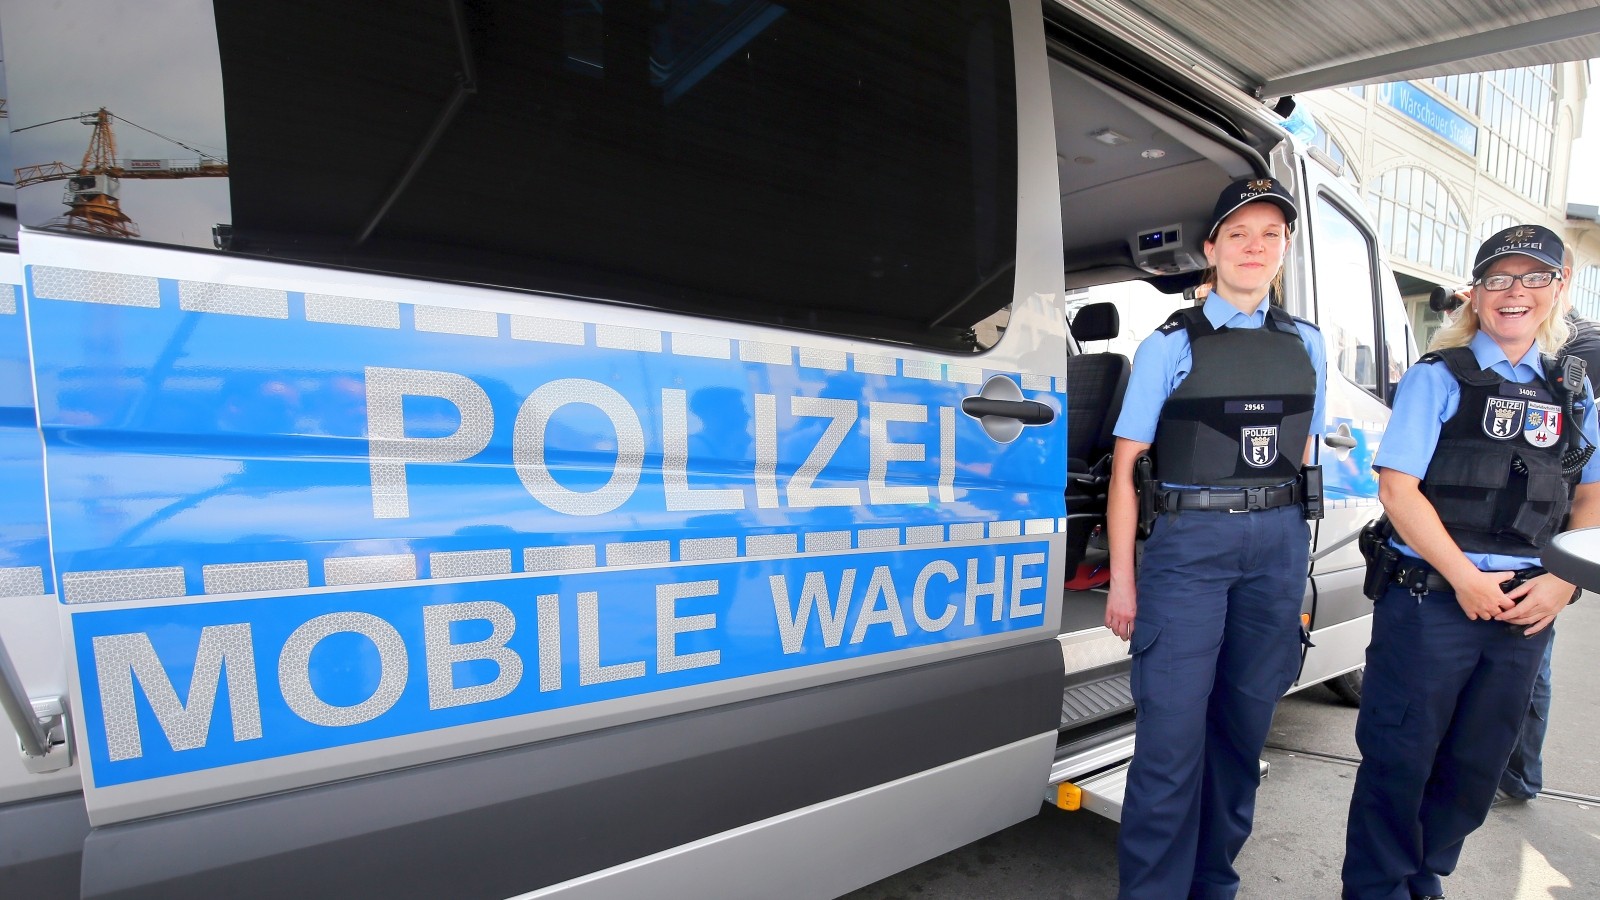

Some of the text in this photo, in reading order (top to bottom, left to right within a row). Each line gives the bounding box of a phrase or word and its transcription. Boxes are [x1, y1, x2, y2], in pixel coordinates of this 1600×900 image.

[1400, 87, 1473, 146] Warschauer Straße
[1494, 242, 1542, 255] POLIZEI
[1519, 388, 1537, 397] 34002
[1244, 403, 1265, 411] 29545
[1489, 399, 1522, 411] POLIZEI
[1245, 428, 1275, 437] POLIZEI
[364, 366, 955, 519] POLIZEI
[92, 552, 1045, 763] MOBILE WACHE
